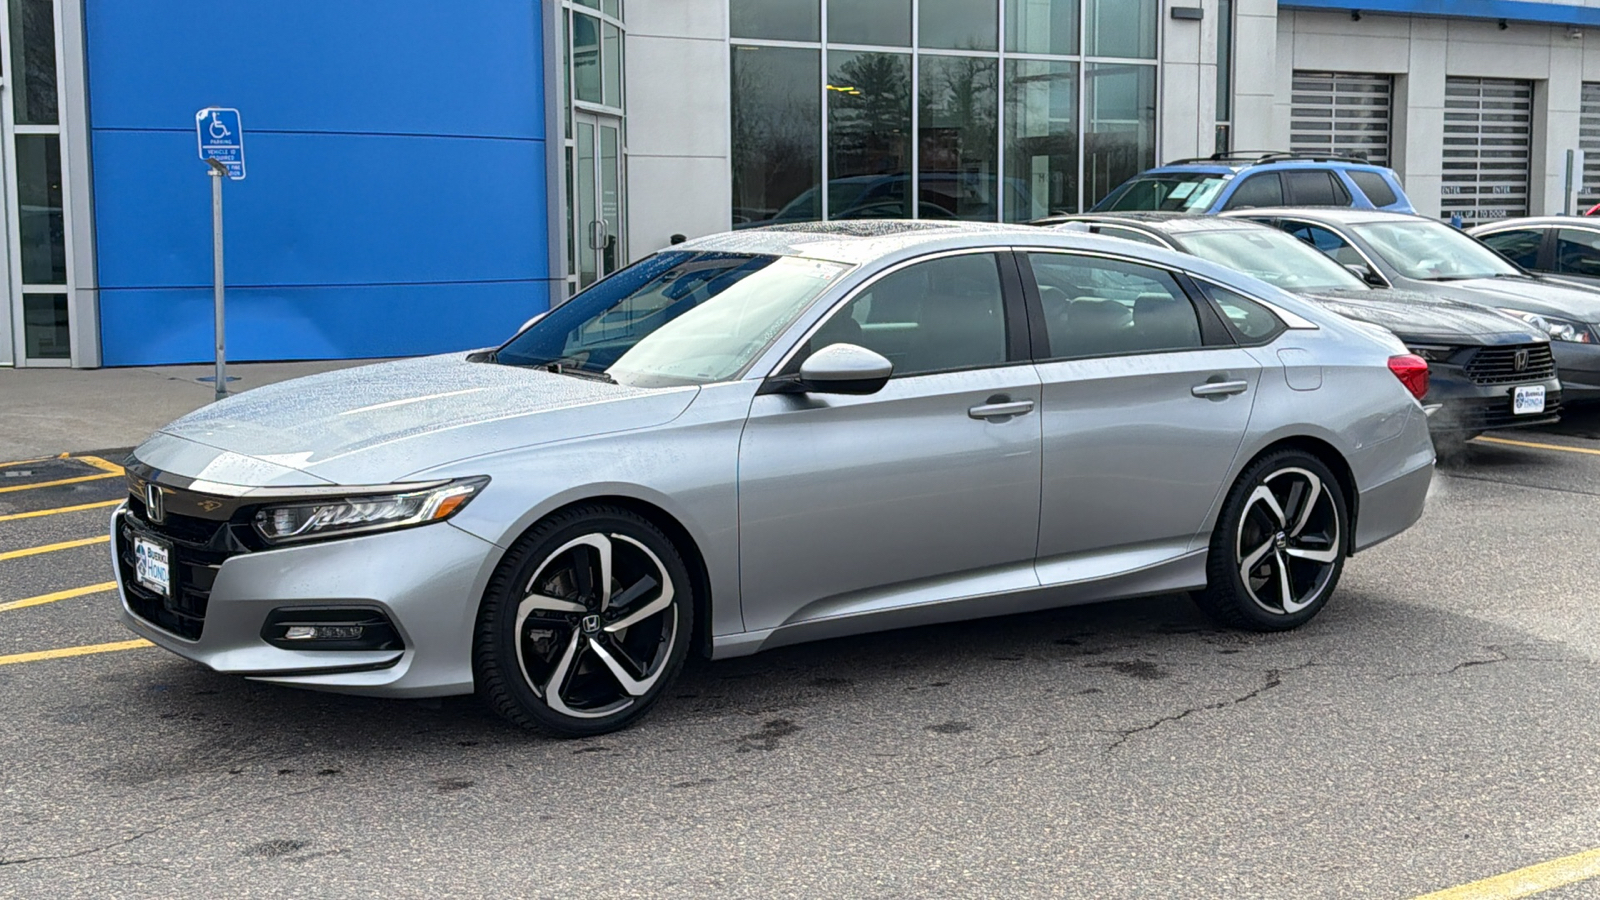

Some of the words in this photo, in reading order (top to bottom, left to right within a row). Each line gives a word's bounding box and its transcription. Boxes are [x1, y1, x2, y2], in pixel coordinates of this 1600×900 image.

[1489, 210, 1507, 218] DOOR
[1524, 398, 1542, 407] HONDA
[147, 546, 169, 564] BUERKL
